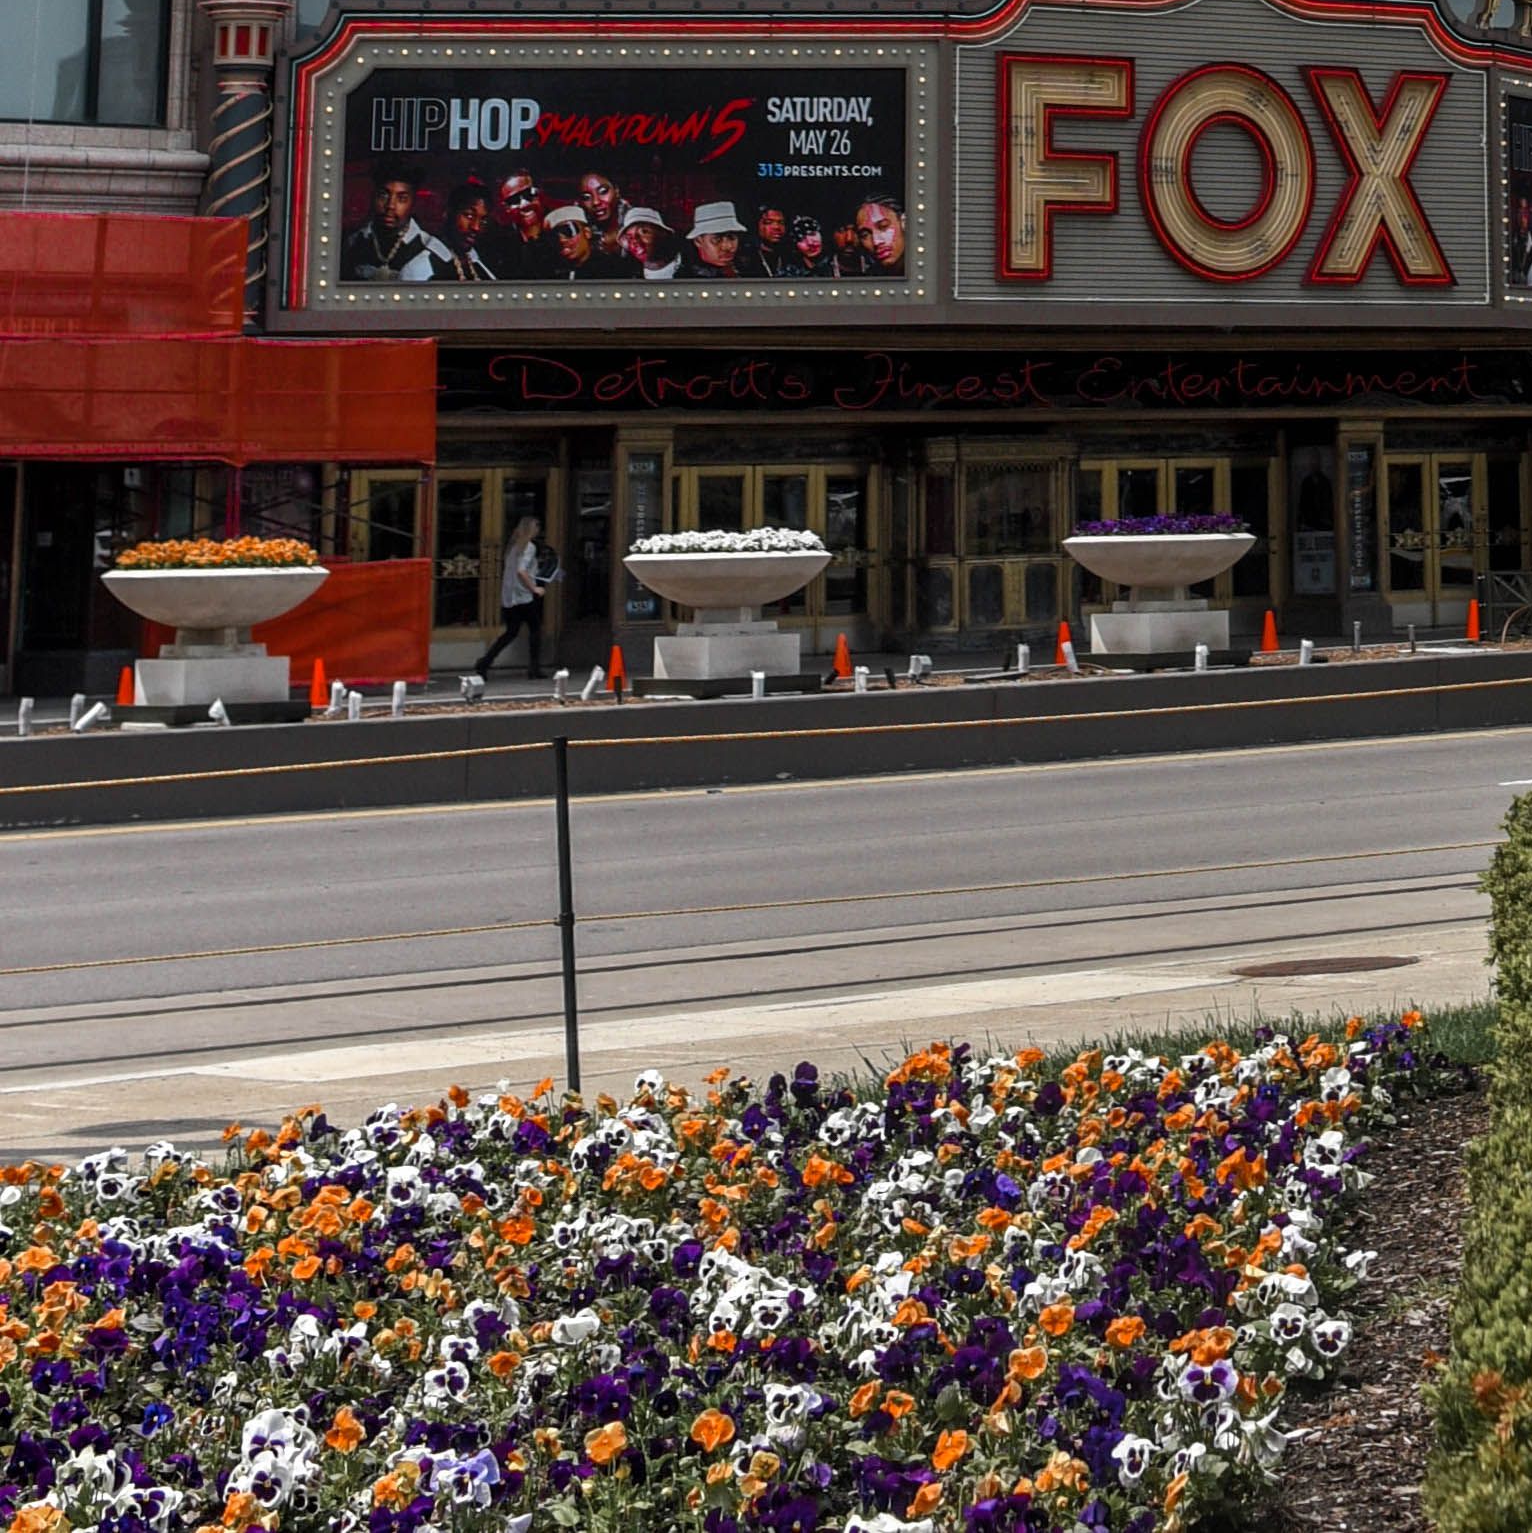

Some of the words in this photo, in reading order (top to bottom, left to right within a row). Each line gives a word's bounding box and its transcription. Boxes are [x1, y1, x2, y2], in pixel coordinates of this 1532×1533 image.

[699, 98, 756, 164] 5
[766, 96, 873, 126] SATURDAY,
[789, 130, 827, 155] MAY
[829, 129, 851, 155] 26
[757, 163, 882, 177] 313PRESENTS.COM
[996, 51, 1454, 287] FOX
[834, 353, 1054, 409] Finest
[1076, 356, 1478, 406] Entertainment
